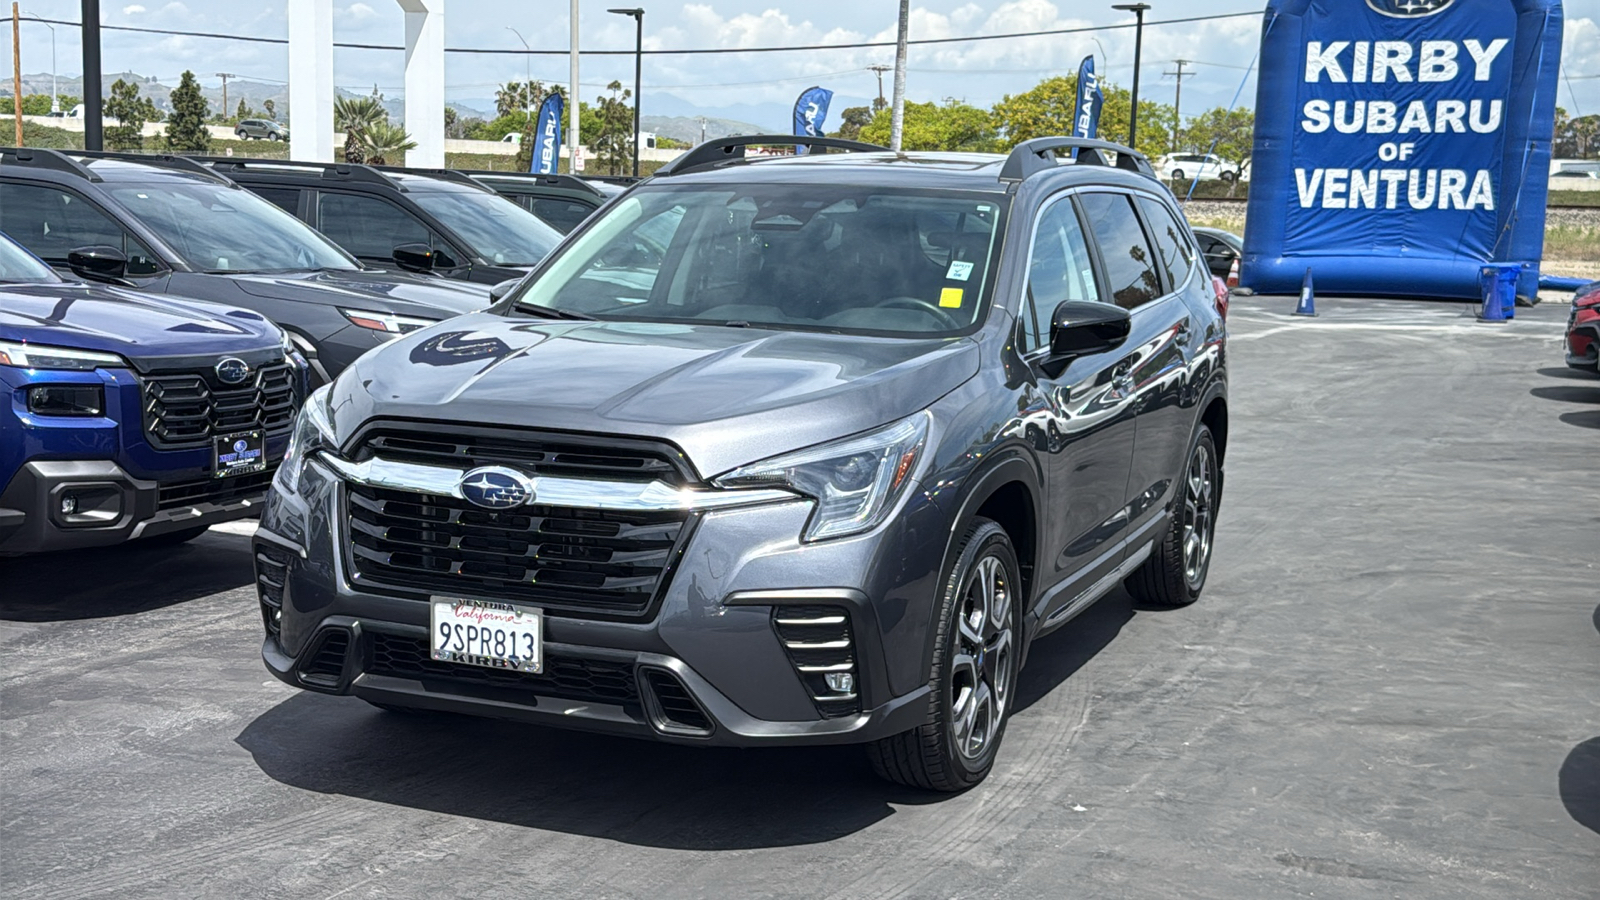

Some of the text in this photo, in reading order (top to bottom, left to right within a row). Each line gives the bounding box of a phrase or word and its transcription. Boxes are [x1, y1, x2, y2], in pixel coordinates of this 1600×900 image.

[1304, 38, 1510, 83] KIRBY
[1078, 72, 1098, 139] UBARU
[1301, 99, 1503, 134] SUBARU
[540, 111, 557, 174] UBARU
[1378, 142, 1415, 162] OF
[1294, 168, 1495, 210] VENTURA
[455, 605, 522, 624] California
[459, 599, 515, 612] VENTURA
[440, 622, 534, 661] 9SPR813
[452, 652, 521, 669] KIRBY
